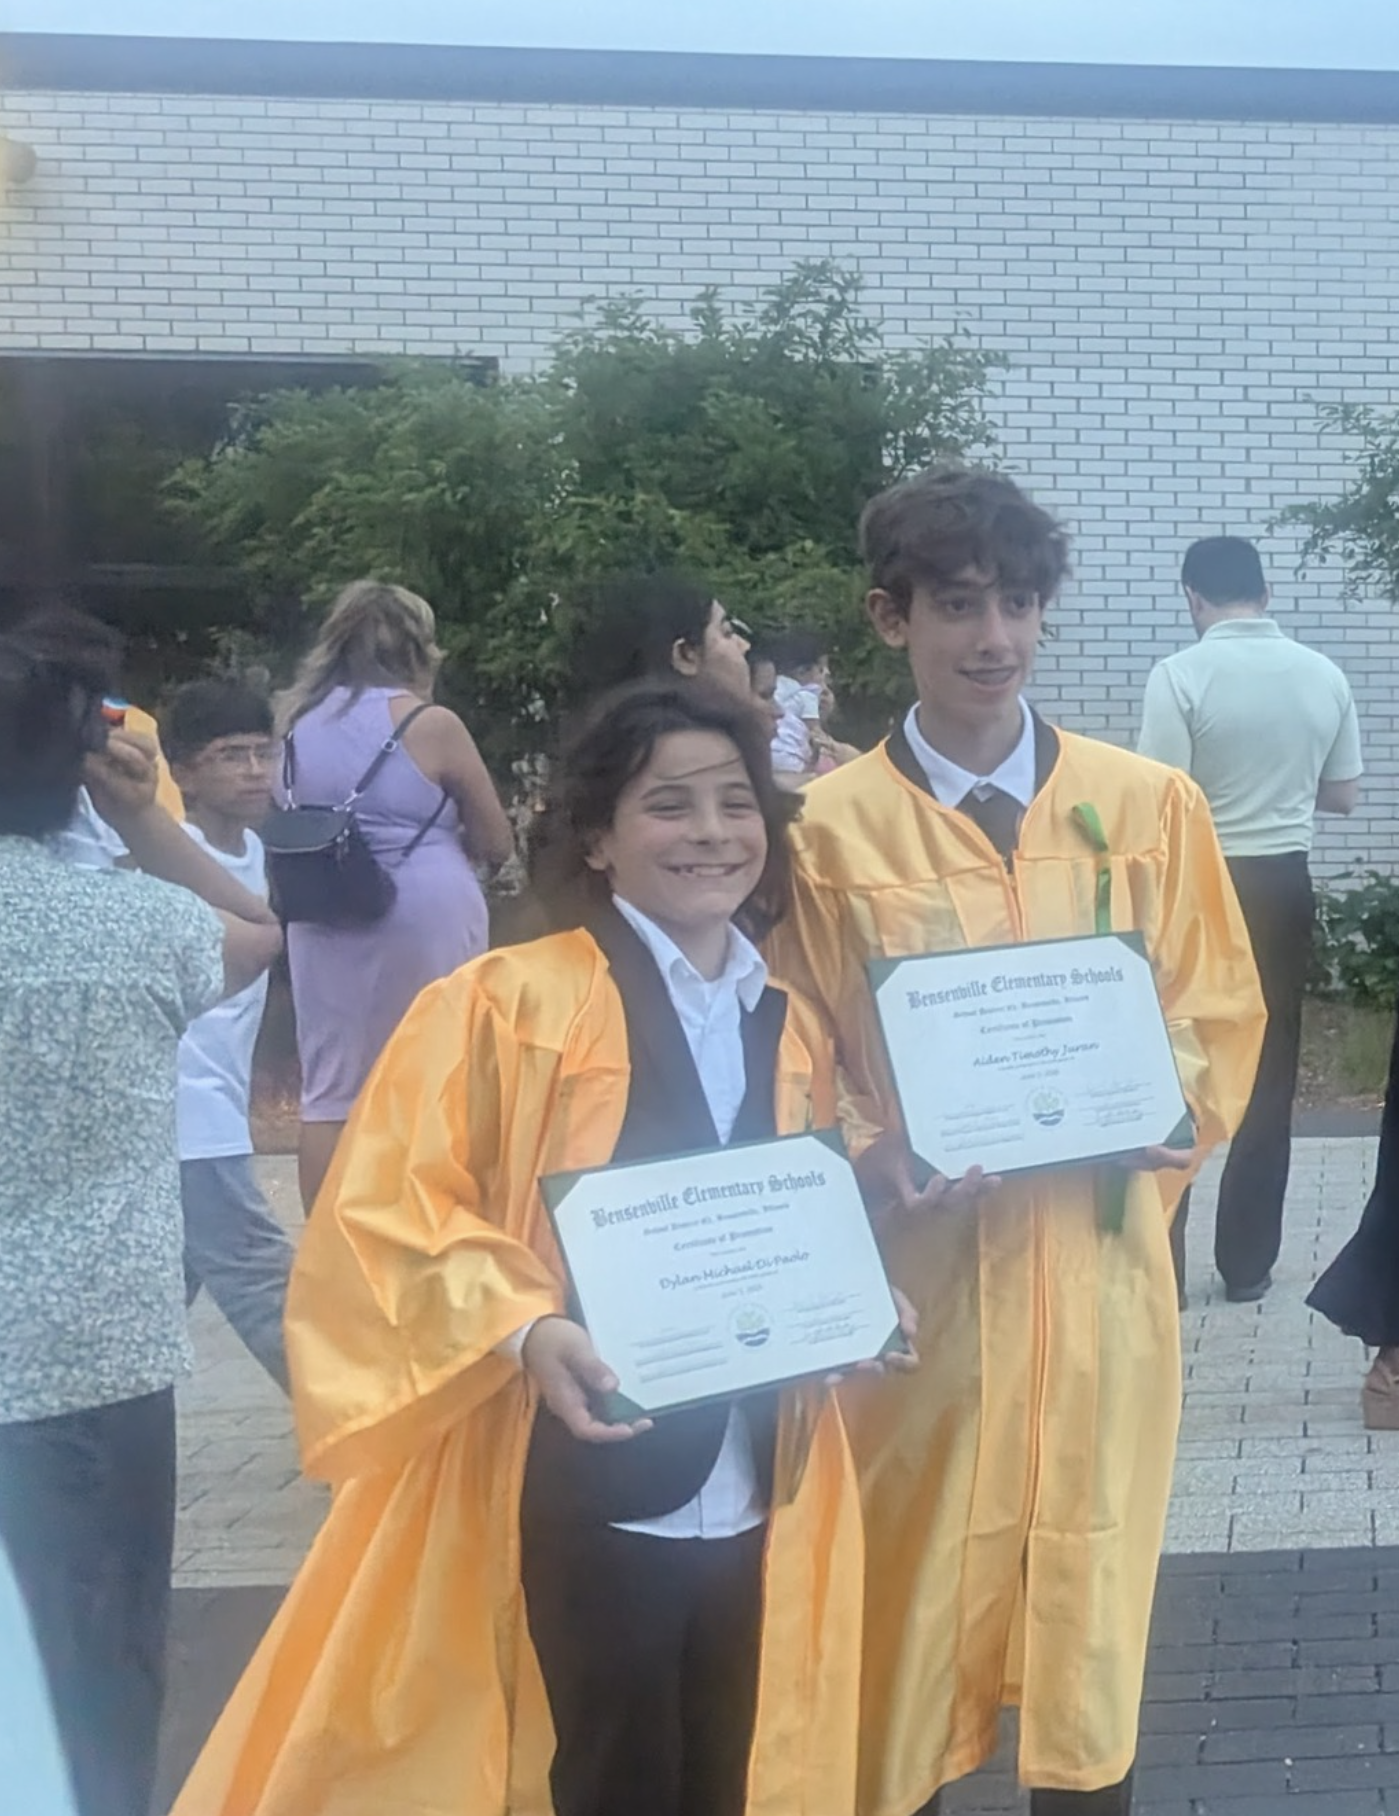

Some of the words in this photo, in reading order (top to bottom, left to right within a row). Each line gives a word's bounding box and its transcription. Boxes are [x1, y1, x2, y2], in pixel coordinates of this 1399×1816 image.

[906, 980, 987, 1009] Bensenville
[990, 973, 1067, 993] Elementary
[1070, 966, 1124, 986] Schools
[1011, 1046, 1060, 1062] Timothy
[590, 1193, 679, 1228] Bensenville
[682, 1180, 764, 1205] Elementary
[767, 1170, 826, 1193] Schools
[659, 1273, 700, 1290] Dylan
[702, 1260, 754, 1281] Michael
